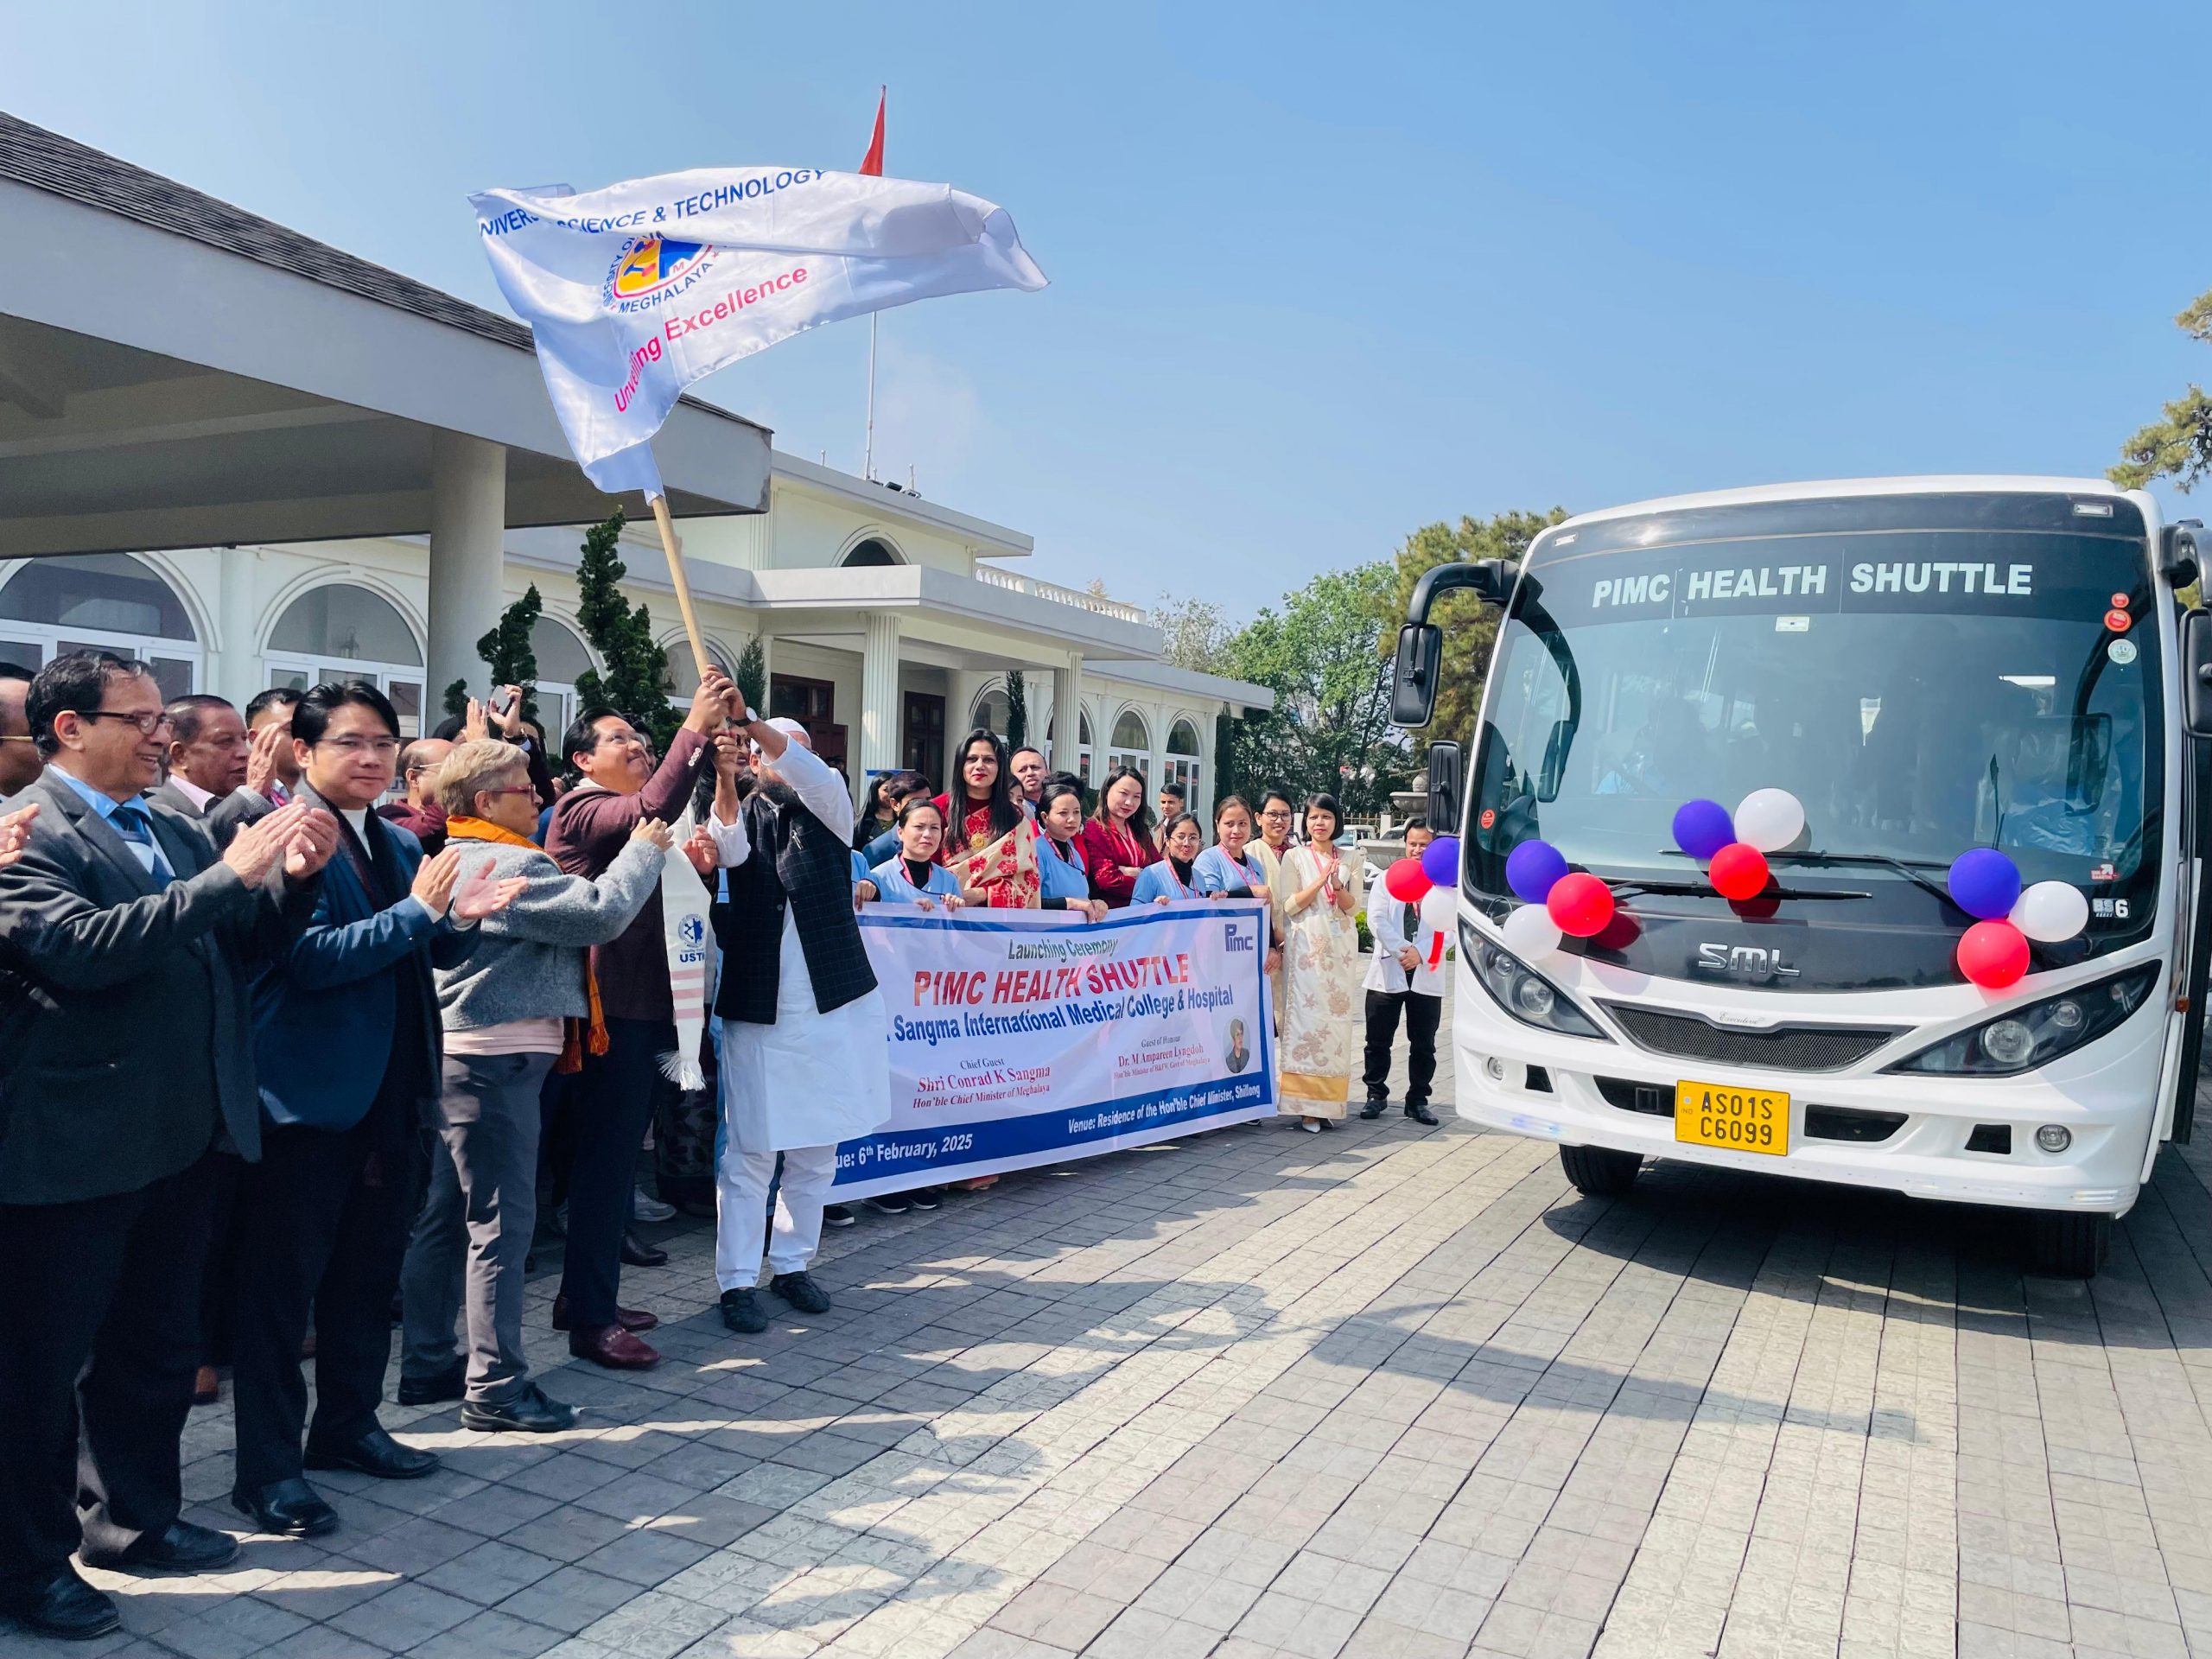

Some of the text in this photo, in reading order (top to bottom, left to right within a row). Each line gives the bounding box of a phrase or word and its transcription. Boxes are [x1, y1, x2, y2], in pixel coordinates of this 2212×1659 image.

[480, 208, 539, 236] NIVER
[652, 207, 666, 223] &
[674, 169, 827, 219] TECHNOLOGY
[619, 262, 713, 314] MEGHALAYA
[614, 268, 808, 413] Unveiling Excellence
[1592, 563, 2032, 608] PIMC HEALTH SHUTTLE
[1008, 938, 1118, 963] Launching Ceremony
[1698, 943, 1801, 976] SML
[914, 953, 1188, 1007] PIMC HEALTH SHUTTLE
[893, 984, 1233, 1046] Sangma International Medical College & Hospital
[961, 1058, 1005, 1070] Chief Guest
[1118, 1043, 1204, 1067] Dr. M Ampareen Lyngdoh
[918, 1066, 1050, 1093] Shri Conrad K Sangma
[950, 1093, 975, 1105] Chief
[976, 1090, 1005, 1103] Minister
[1007, 1089, 1014, 1098] of
[1016, 1084, 1050, 1097] Meghalaya
[1068, 1118, 1096, 1135] Venue:
[1097, 1109, 1135, 1129] Residence
[1137, 1106, 1145, 1120] of
[1145, 1103, 1157, 1117] the
[1189, 1092, 1206, 1109] Chief
[1208, 1088, 1235, 1105] Minister,
[1235, 1084, 1261, 1100] Shillong
[1701, 1091, 1773, 1120] AS01S
[1700, 1116, 1771, 1146] C6099
[836, 1134, 973, 1168] ue: 6th February, 2025
